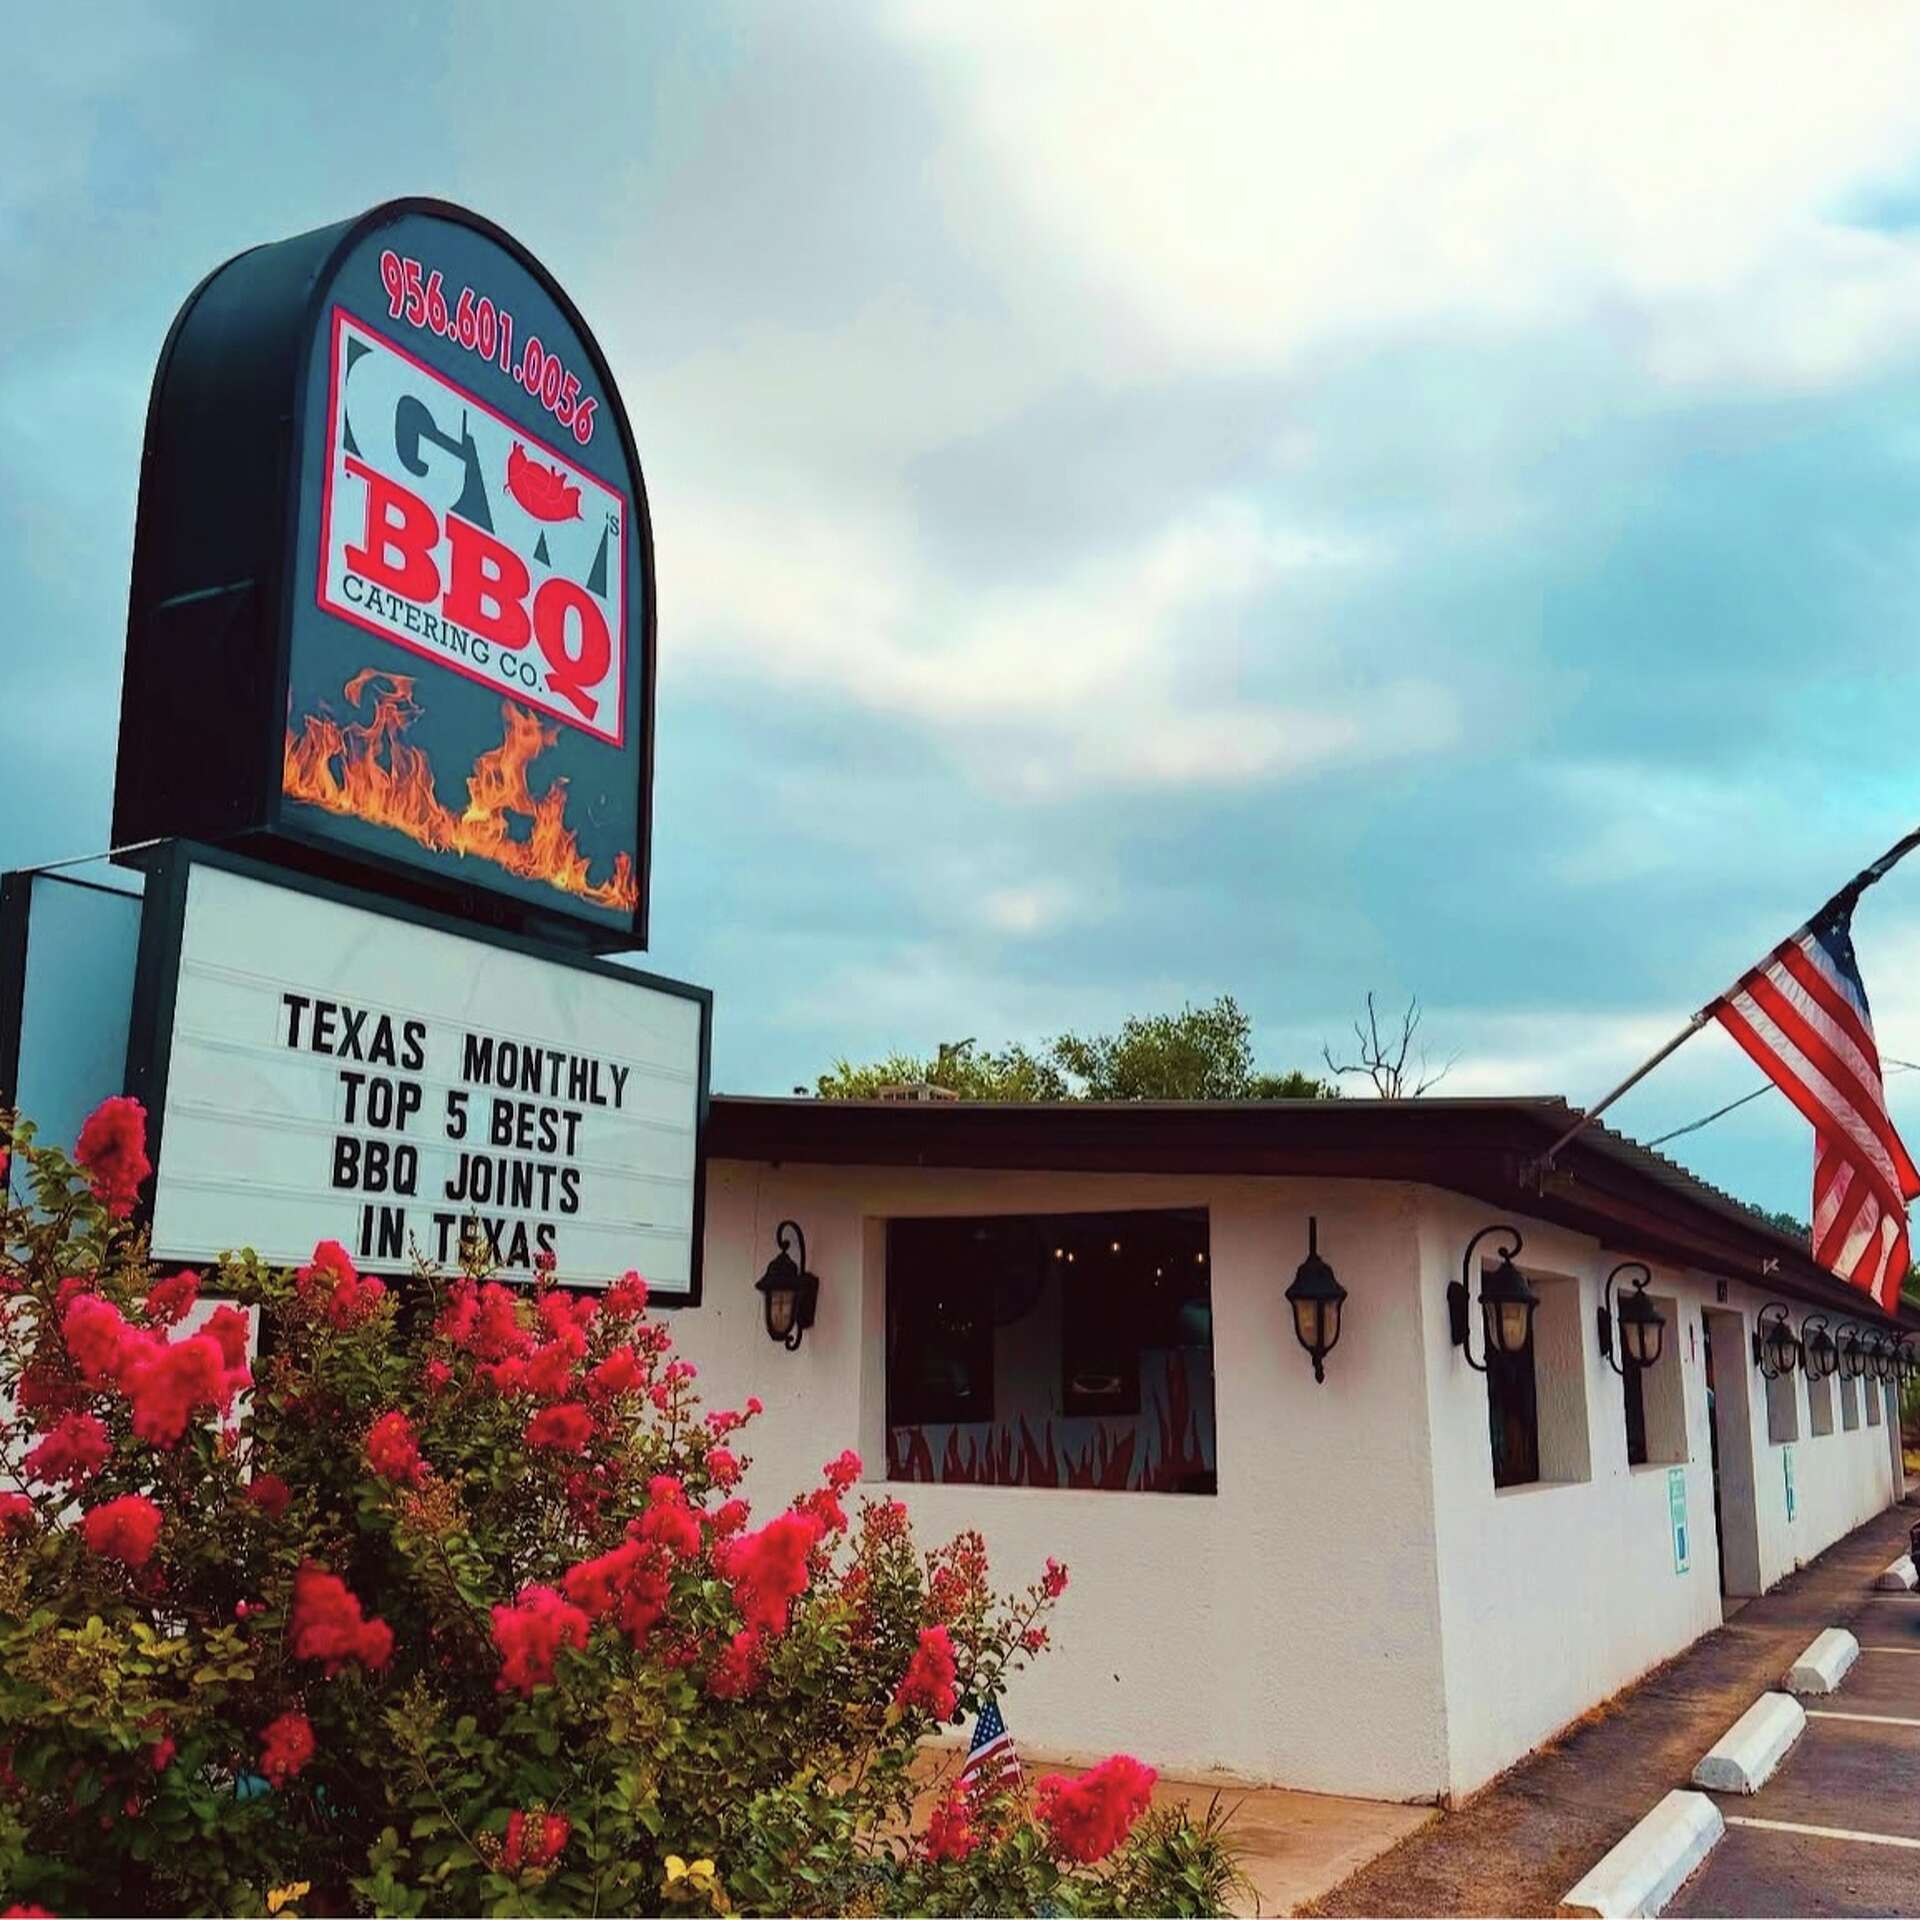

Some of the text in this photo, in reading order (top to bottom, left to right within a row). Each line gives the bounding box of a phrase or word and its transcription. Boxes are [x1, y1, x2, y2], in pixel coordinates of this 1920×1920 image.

[381, 250, 597, 444] 956.601.0056
[342, 574, 543, 692] CATERING CO.
[343, 455, 612, 722] BBQ
[283, 993, 630, 1108] TEXAS MONTHLY
[340, 1071, 583, 1156] TOP 5 BEST
[333, 1135, 581, 1214] BBQ JOINTS
[360, 1205, 405, 1258] IN
